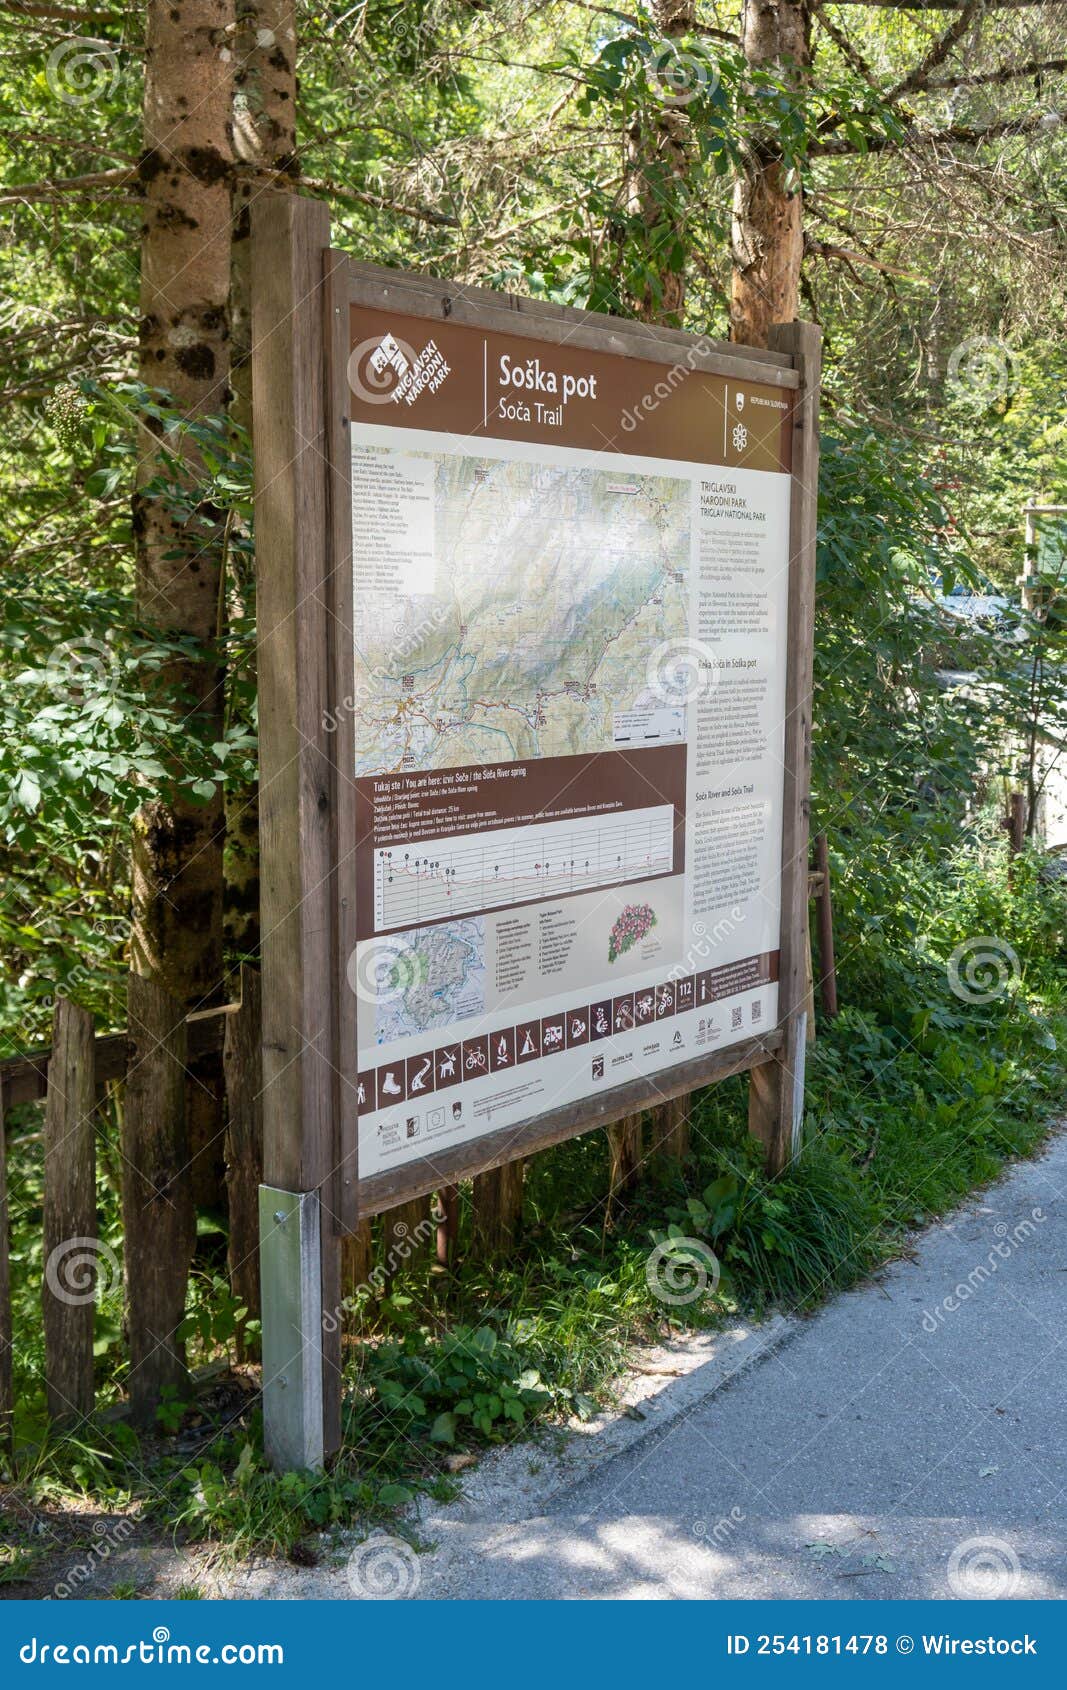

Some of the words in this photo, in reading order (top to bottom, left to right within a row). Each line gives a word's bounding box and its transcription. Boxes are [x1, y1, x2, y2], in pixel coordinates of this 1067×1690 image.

[391, 339, 438, 405] TRIGLAVSKI
[405, 351, 444, 407] NARODNI
[428, 365, 452, 395] PARK
[499, 355, 557, 393] Soška
[562, 374, 597, 404] pot
[499, 397, 531, 422] Soča
[534, 402, 563, 426] Trail
[700, 481, 737, 494] TRIGLAVSKI
[700, 495, 732, 507] NARODNI
[732, 498, 747, 508] PARK
[700, 507, 724, 518] TRIGLAV
[724, 510, 752, 521] NATIONAL
[752, 512, 767, 521] PARK
[374, 781, 391, 793] Tukaj
[391, 781, 400, 790] ste
[406, 778, 417, 789] You
[418, 778, 427, 787] are
[428, 776, 442, 786] here:
[473, 771, 482, 781] the
[497, 768, 510, 778] River
[511, 767, 527, 778] spring
[679, 982, 692, 996] 112
